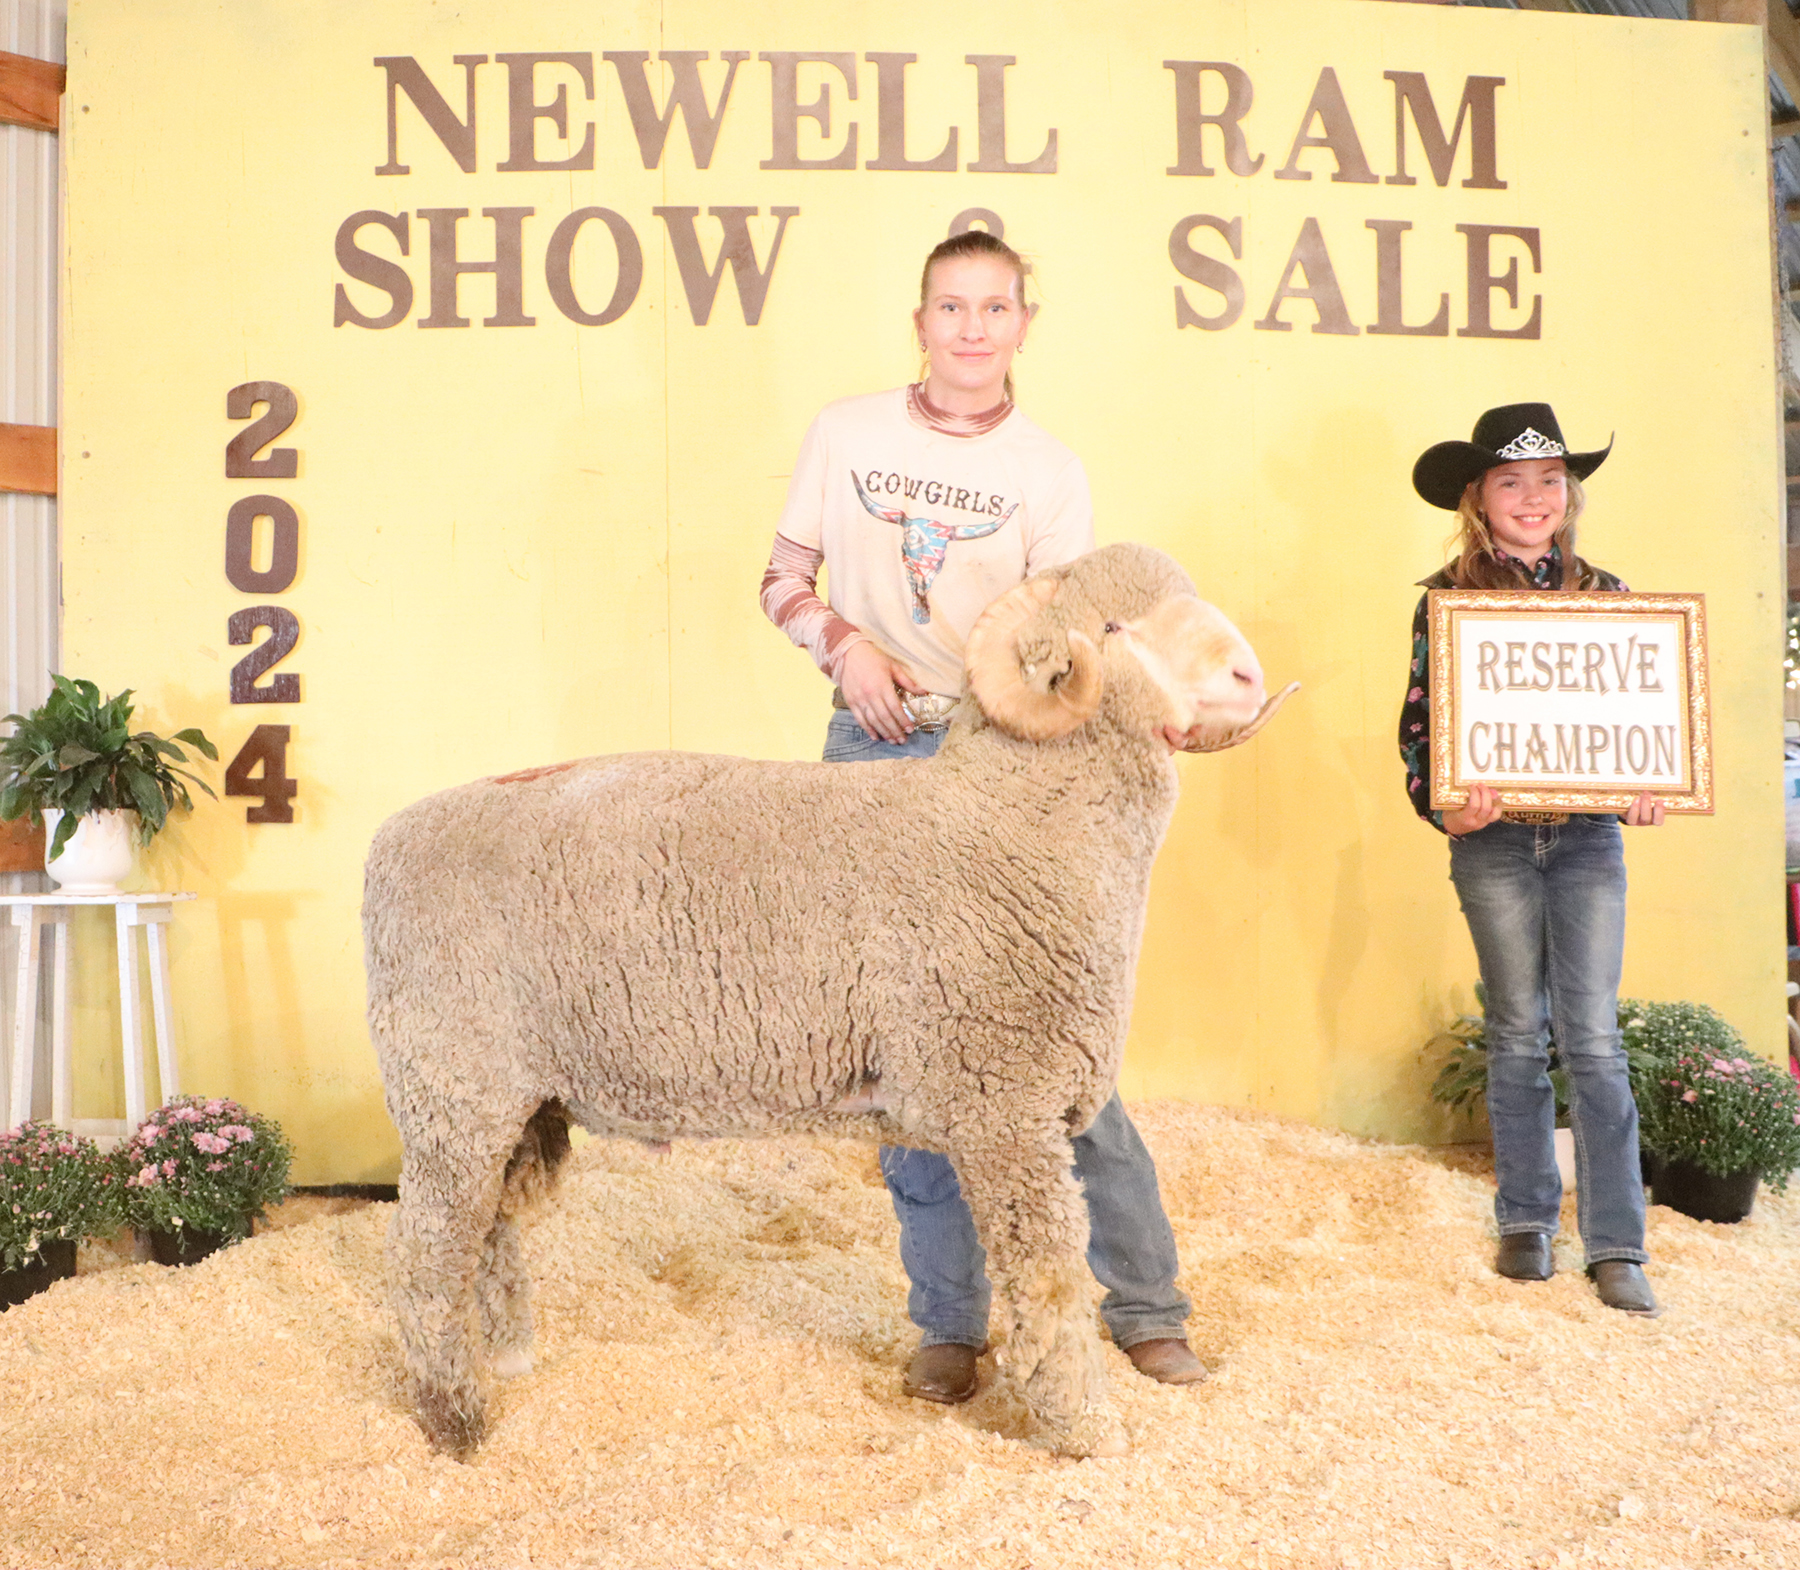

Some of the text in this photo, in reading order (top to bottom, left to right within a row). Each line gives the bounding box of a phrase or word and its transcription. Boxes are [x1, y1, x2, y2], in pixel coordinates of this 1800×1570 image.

[373, 50, 1508, 190] NEWELL RAM
[333, 206, 800, 330] SHOW
[1168, 213, 1542, 340] SALE
[865, 471, 1004, 517] COWGIRLS
[225, 380, 301, 824] 2024
[1477, 634, 1663, 695] RESERVE
[1468, 722, 1676, 776] CHAMPION
